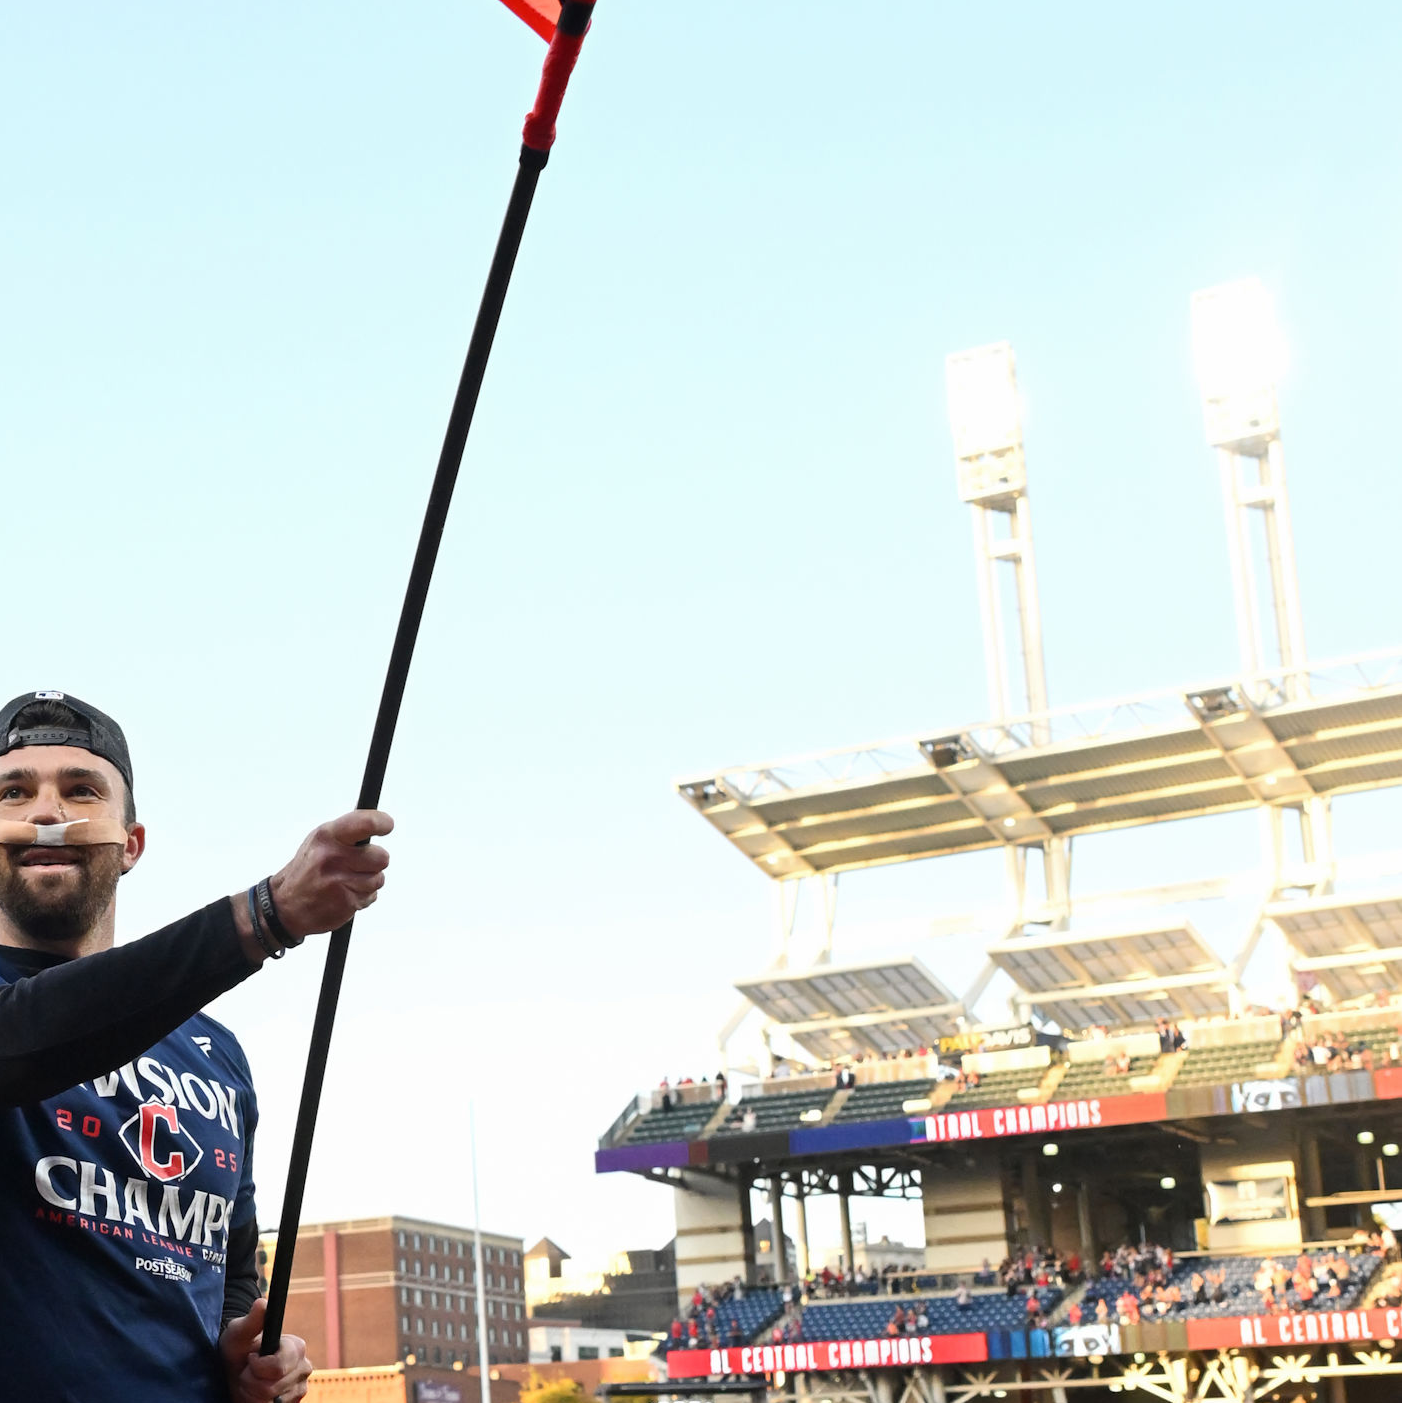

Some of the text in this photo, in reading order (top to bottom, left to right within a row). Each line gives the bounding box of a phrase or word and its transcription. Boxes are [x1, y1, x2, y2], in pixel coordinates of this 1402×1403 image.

[79, 1057, 240, 1140] VISION
[993, 1099, 1102, 1135] CHAMPIONS
[56, 1108, 237, 1173] 20 25
[35, 1207, 194, 1258] AMERICAN LEAGUE
[135, 1257, 193, 1283] POSTSEASON
[1278, 1311, 1373, 1344] CENTRAL
[741, 1344, 818, 1373] CENTRAL
[828, 1337, 933, 1369] CHAMPIONS
